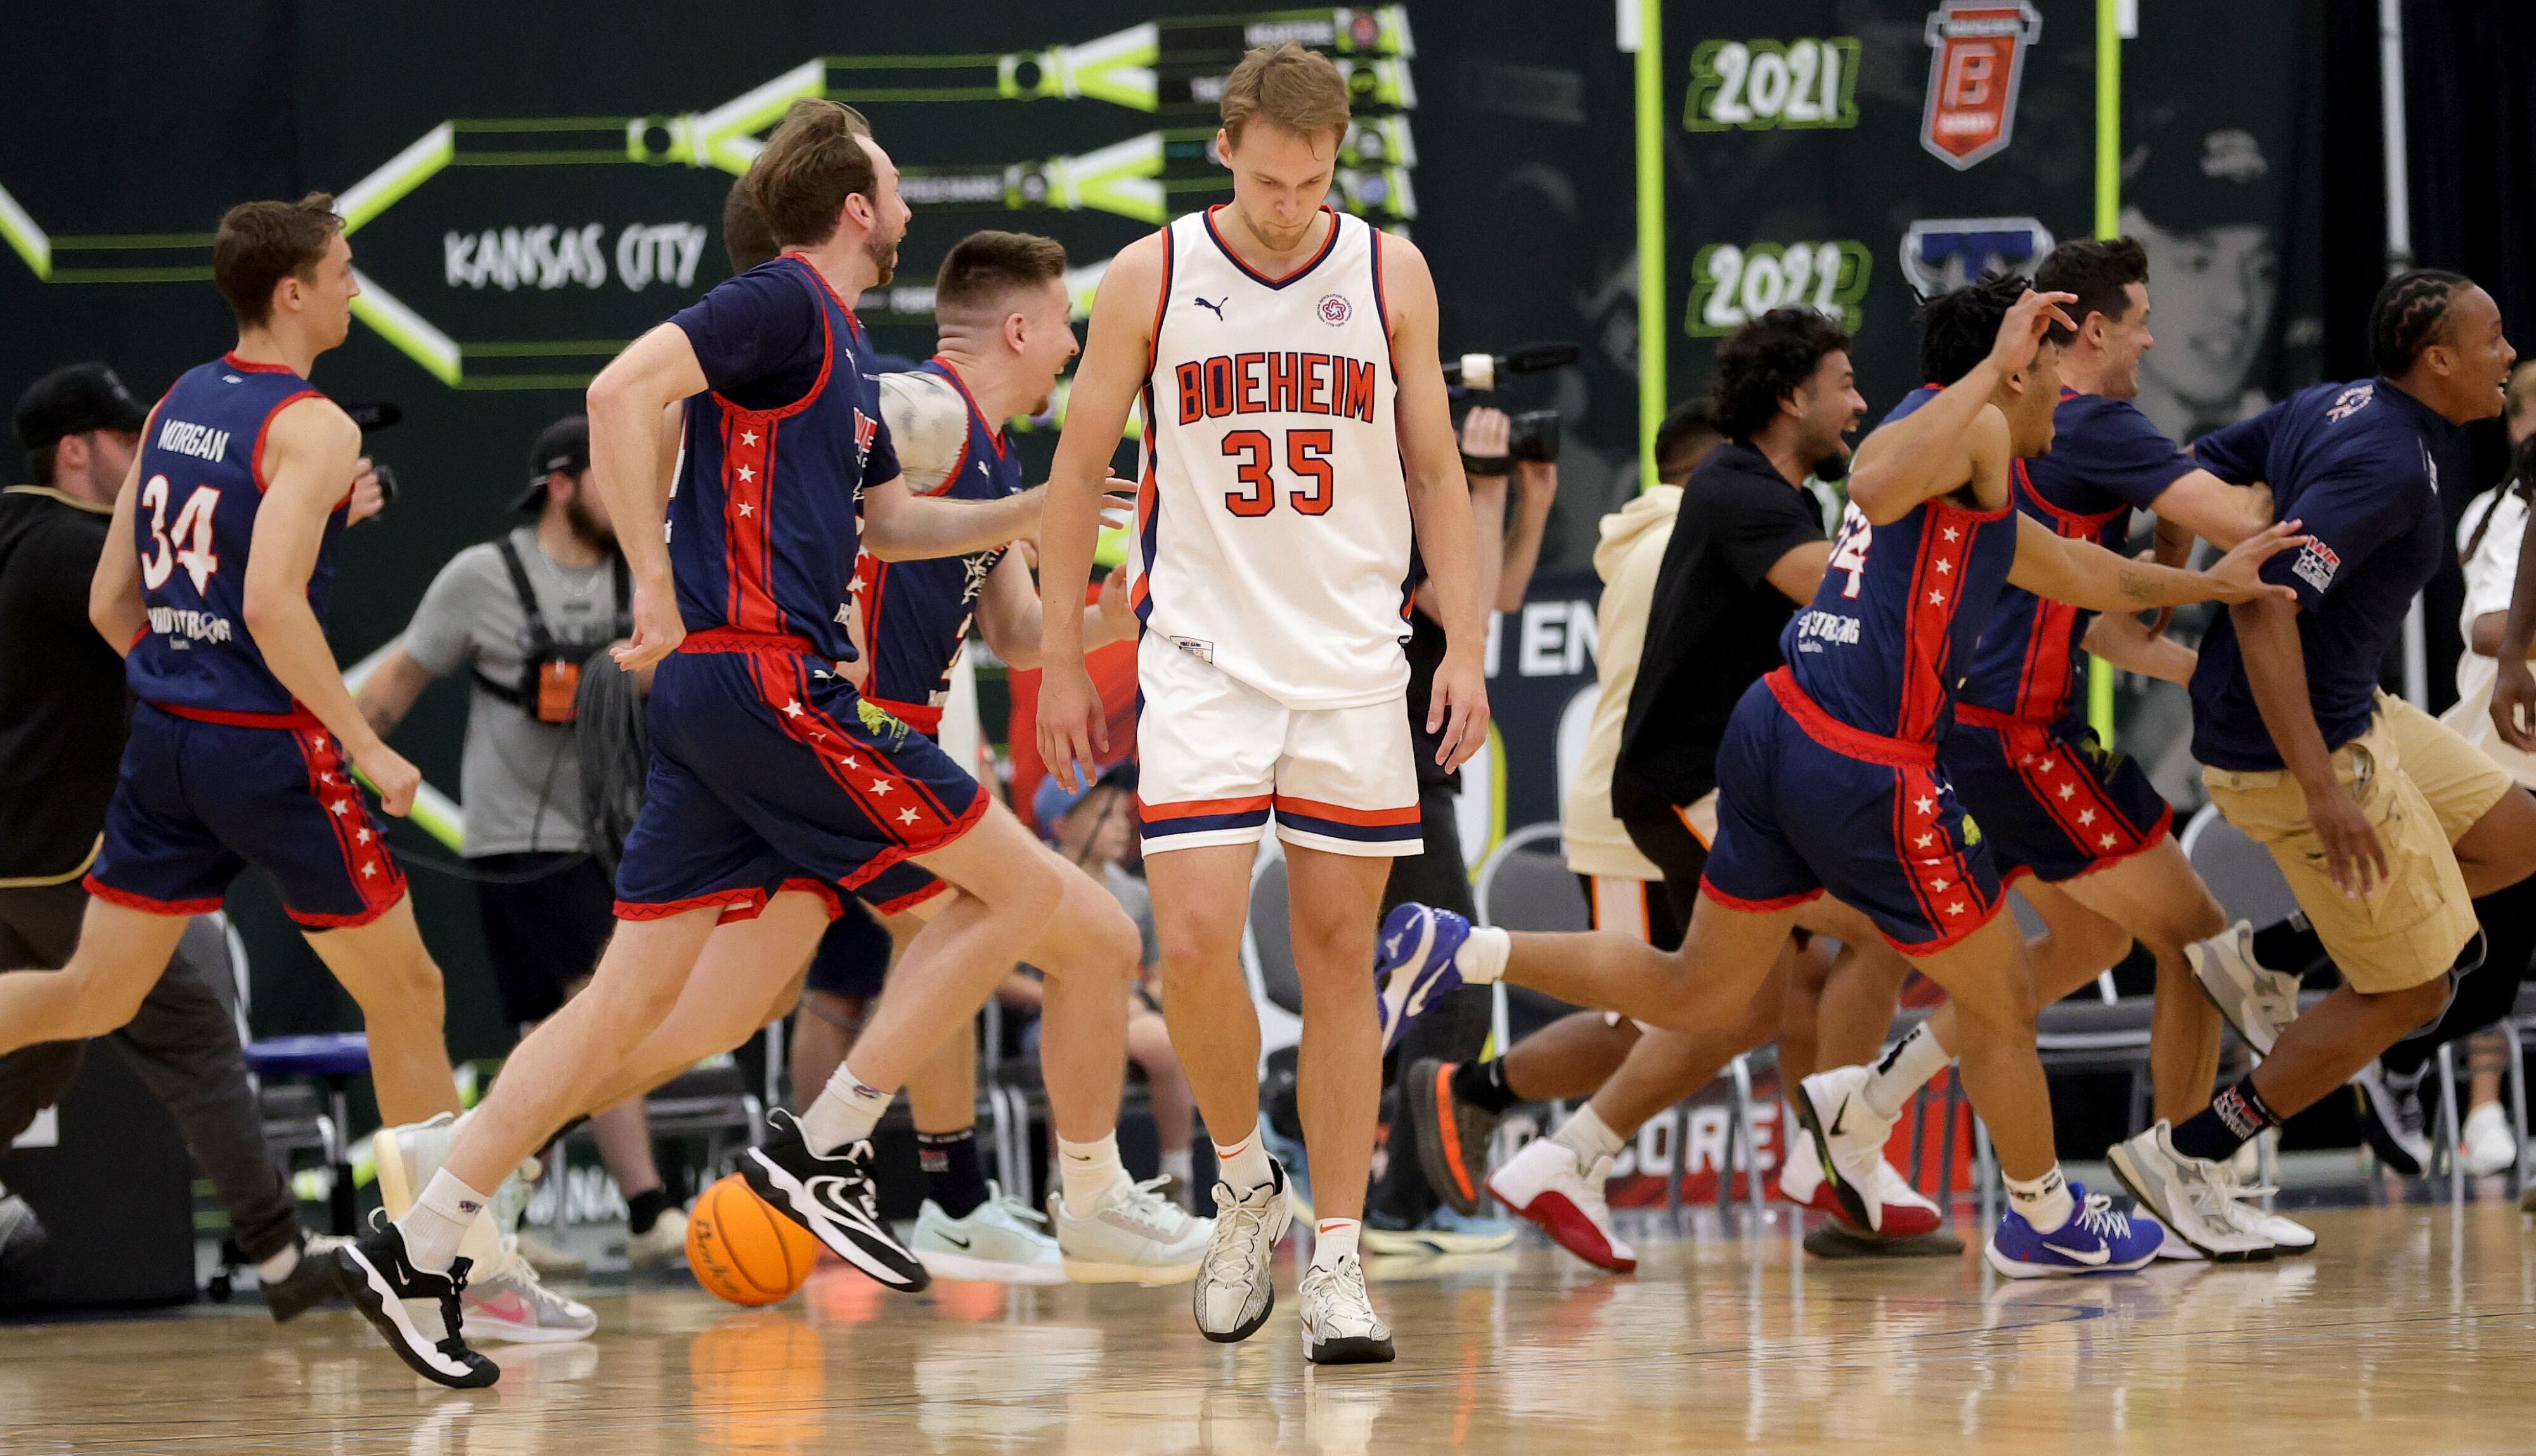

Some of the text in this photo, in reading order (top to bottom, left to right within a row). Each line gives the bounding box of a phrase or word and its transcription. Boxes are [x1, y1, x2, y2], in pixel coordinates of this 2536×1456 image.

[1707, 38, 1842, 125] 2021
[444, 222, 708, 292] KANSAS CITY
[1702, 241, 1846, 328] 2022
[1175, 351, 1376, 427] BOEHEIM
[157, 418, 231, 464] MORGAN
[1221, 428, 1334, 518] 35
[140, 472, 221, 598] 34
